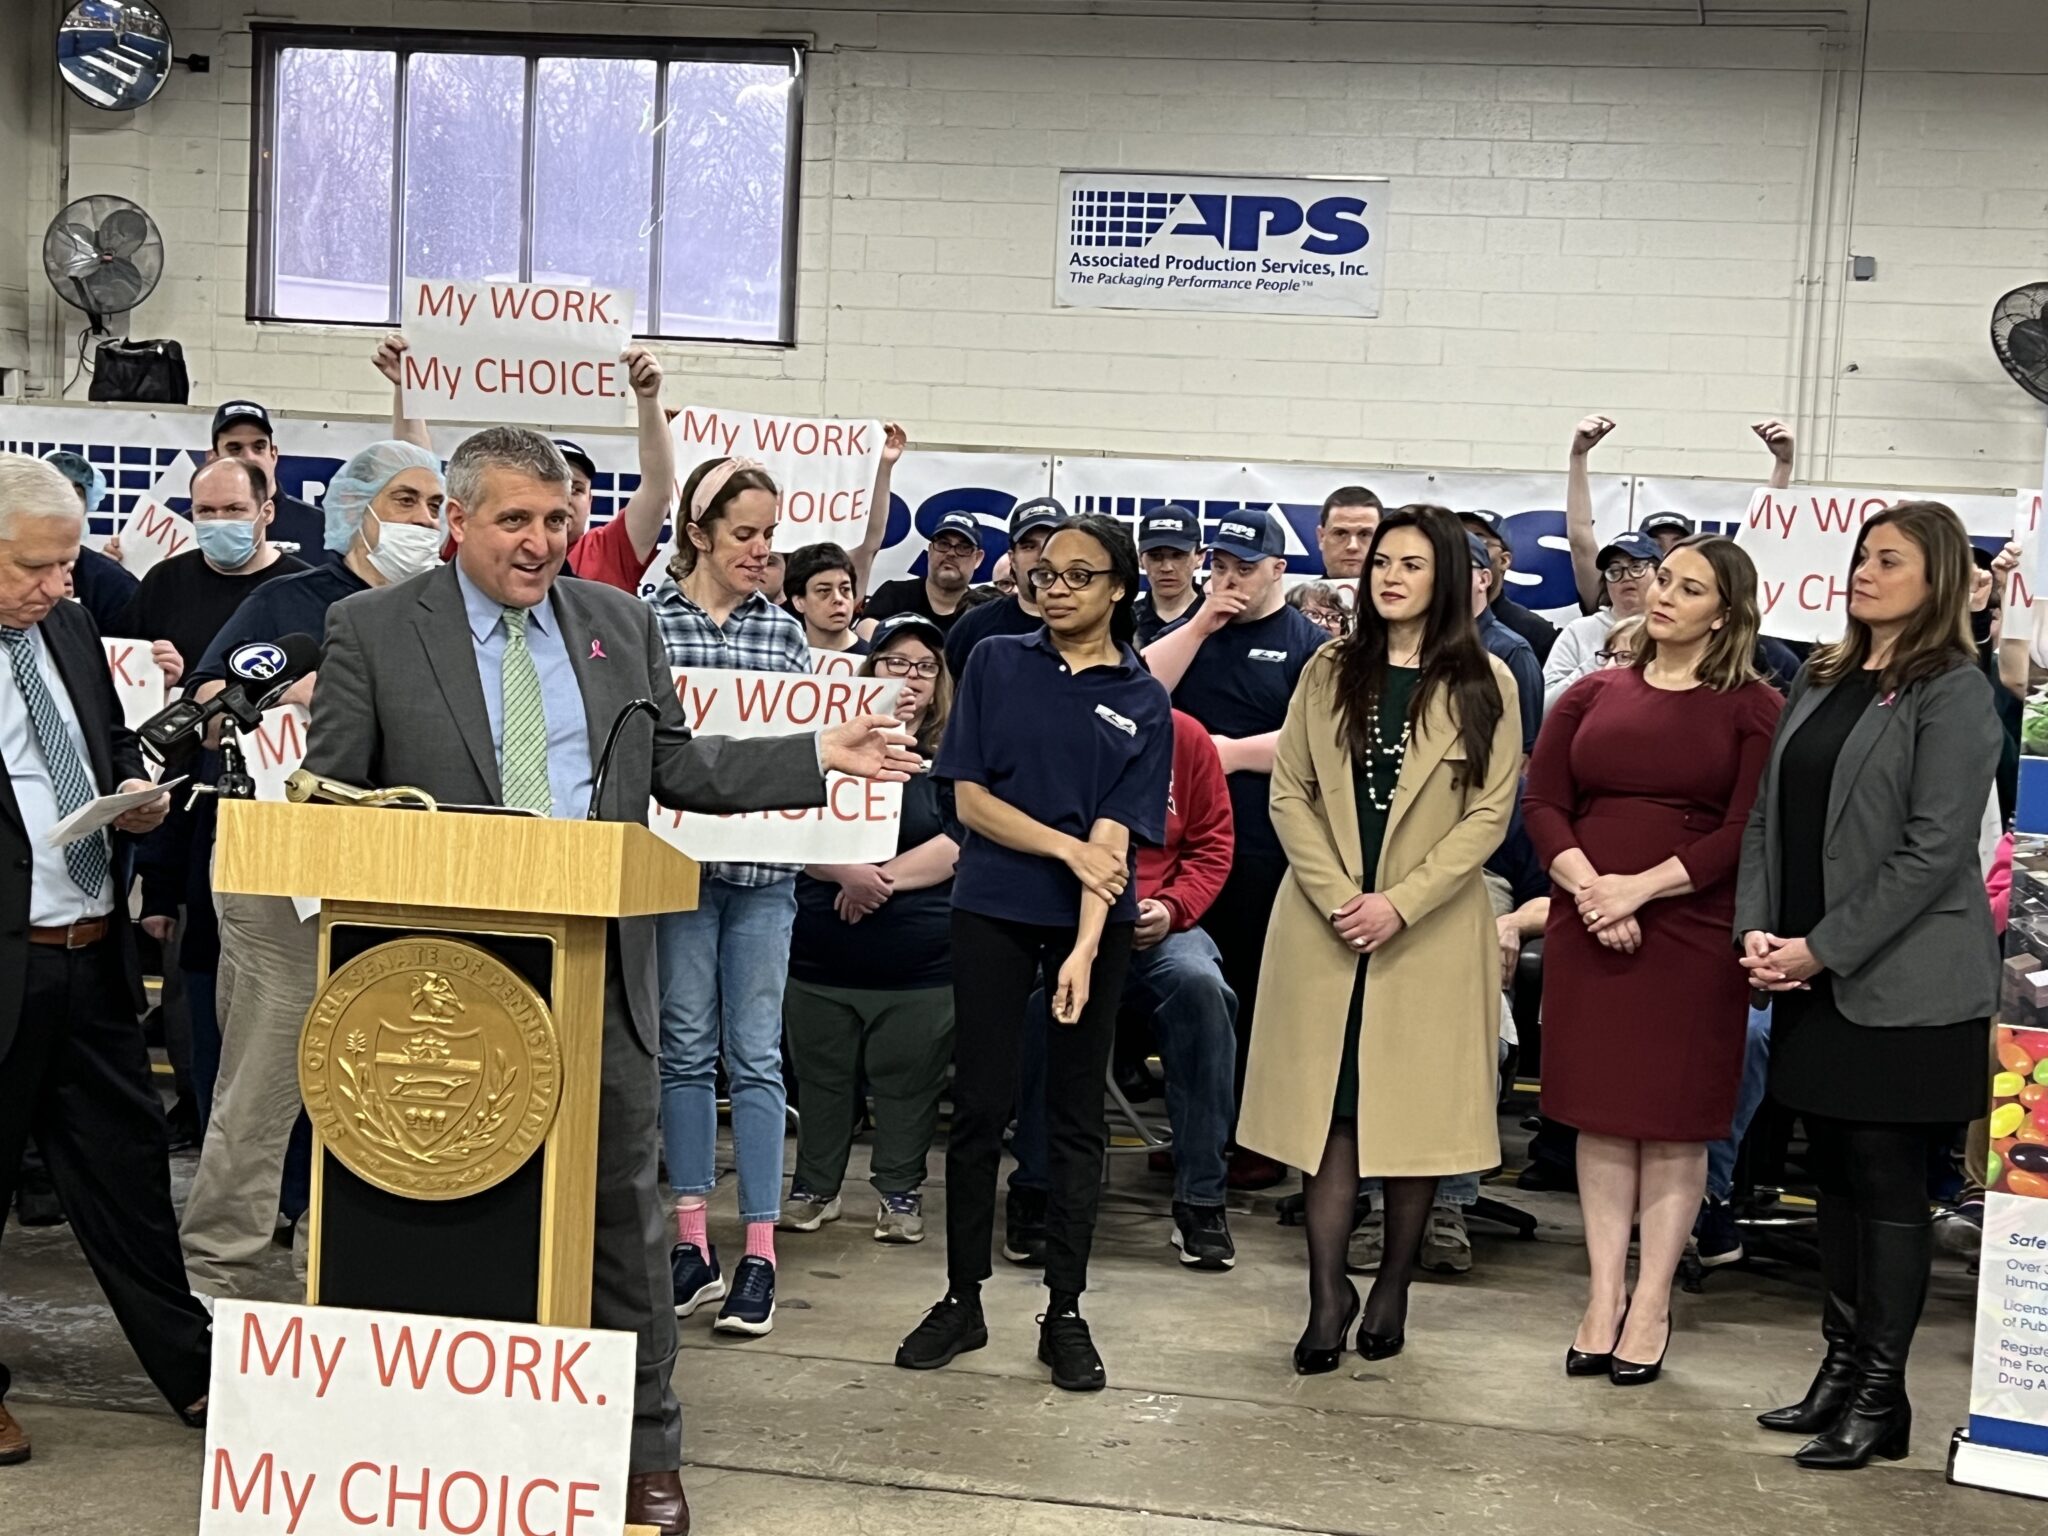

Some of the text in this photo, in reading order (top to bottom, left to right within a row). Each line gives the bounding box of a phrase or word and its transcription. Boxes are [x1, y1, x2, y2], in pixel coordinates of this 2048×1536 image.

[1144, 193, 1369, 255] APS
[1069, 252, 1369, 277] Associated Production Services, Inc.
[1069, 272, 1094, 284] The
[1097, 273, 1164, 289] Packaging
[1168, 276, 1251, 290] Performance
[418, 284, 620, 325] My WORK.
[405, 356, 627, 399] My CHOICE.
[683, 410, 872, 458] My WORK.
[777, 488, 868, 523] OICE.
[136, 503, 190, 558] My
[306, 946, 554, 1156] SEAL OF THE SENATE OF PENNSYLVANIA
[2006, 1258, 2041, 1274] Over
[2002, 1316, 2017, 1328] of
[240, 1312, 607, 1406] My WORK.
[2000, 1356, 2022, 1369] the
[1999, 1372, 2034, 1391] Drug
[211, 1448, 600, 1536] My CHOICE
